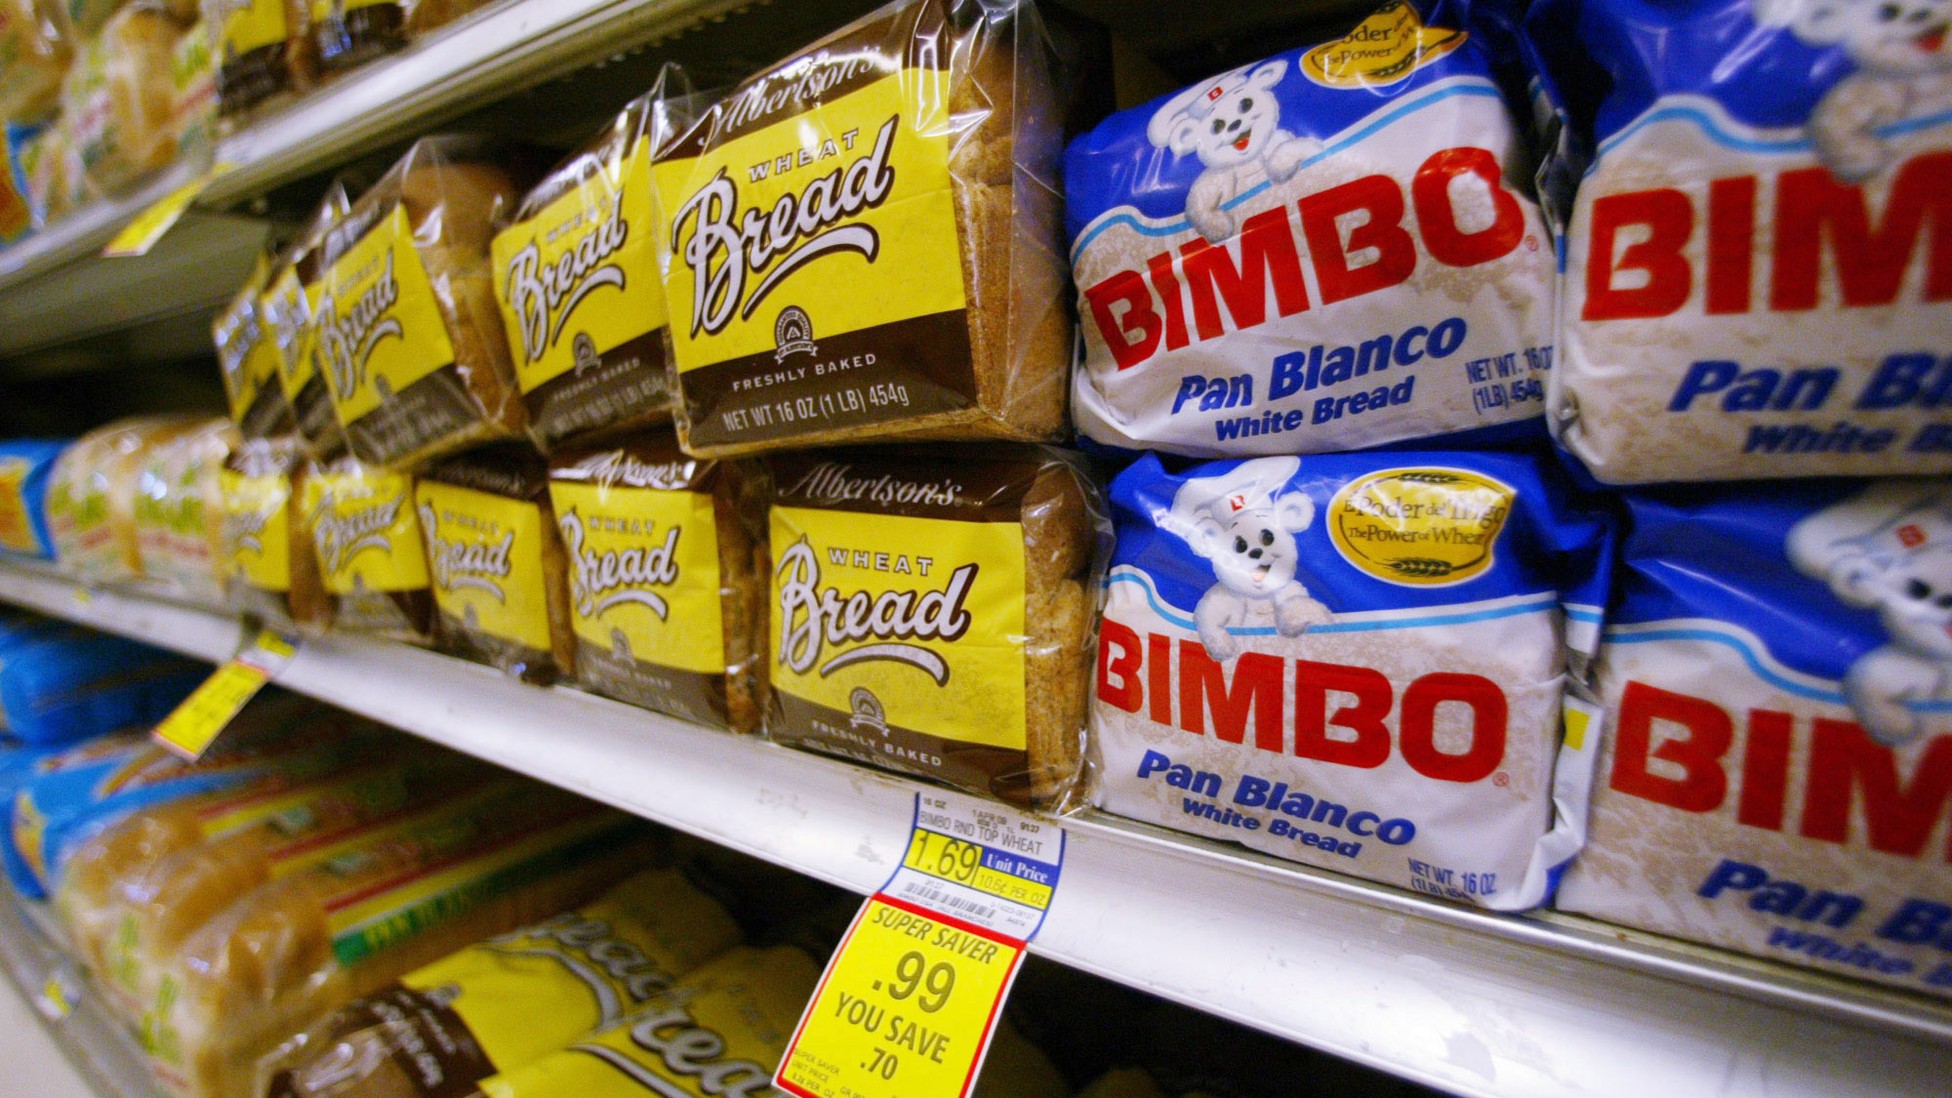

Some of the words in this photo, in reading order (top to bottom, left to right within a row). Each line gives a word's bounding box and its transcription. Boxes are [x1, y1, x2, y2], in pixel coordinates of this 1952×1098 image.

[1343, 25, 1392, 45] oder
[748, 128, 860, 184] WHEAT
[671, 113, 900, 340] Bread
[503, 187, 628, 367] Bread
[1084, 146, 1526, 372] BIMBO
[732, 367, 806, 392] FRESHLY
[815, 353, 877, 376] BAKED
[1171, 373, 1254, 415] Pan
[1267, 316, 1468, 401] Blanco
[1465, 357, 1492, 385] NET
[1666, 359, 1843, 413] Pan
[723, 411, 750, 432] NET
[750, 405, 774, 427] WT
[776, 401, 794, 423] 16
[797, 397, 818, 420] OZ
[869, 383, 911, 407] 454g
[1215, 409, 1303, 442] White
[1310, 376, 1416, 426] Bread
[778, 462, 963, 507] Albertson's
[1347, 527, 1367, 539] The
[1366, 524, 1418, 542] Power
[559, 504, 682, 618] Bread
[827, 546, 934, 577] WHEAT
[776, 532, 979, 676] Bread
[1097, 615, 1508, 784] BIMBO
[883, 743, 943, 767] BAKED
[1136, 748, 1223, 799] Pan
[1232, 774, 1416, 846] Blanco
[920, 810, 951, 830] BIMBO
[953, 819, 975, 837] RND
[978, 826, 999, 843] TOP
[1001, 832, 1043, 855] WHEAT
[1182, 796, 1261, 831] White
[1268, 818, 1363, 860] Bread
[914, 832, 978, 881] 1.69
[986, 853, 1013, 874] Unit
[1015, 862, 1049, 884] Price
[1407, 857, 1431, 879] NET
[1461, 871, 1477, 895] 16
[1480, 872, 1497, 896] OZ
[1008, 883, 1029, 899] PER
[1031, 888, 1047, 906] OZ
[1697, 858, 1865, 929] Pan
[871, 906, 935, 942] SUPER
[932, 927, 999, 965] SAVER
[872, 950, 956, 1014] .99
[835, 991, 885, 1033] YOU
[884, 1015, 951, 1065] SAVE
[860, 1047, 899, 1081] .70
